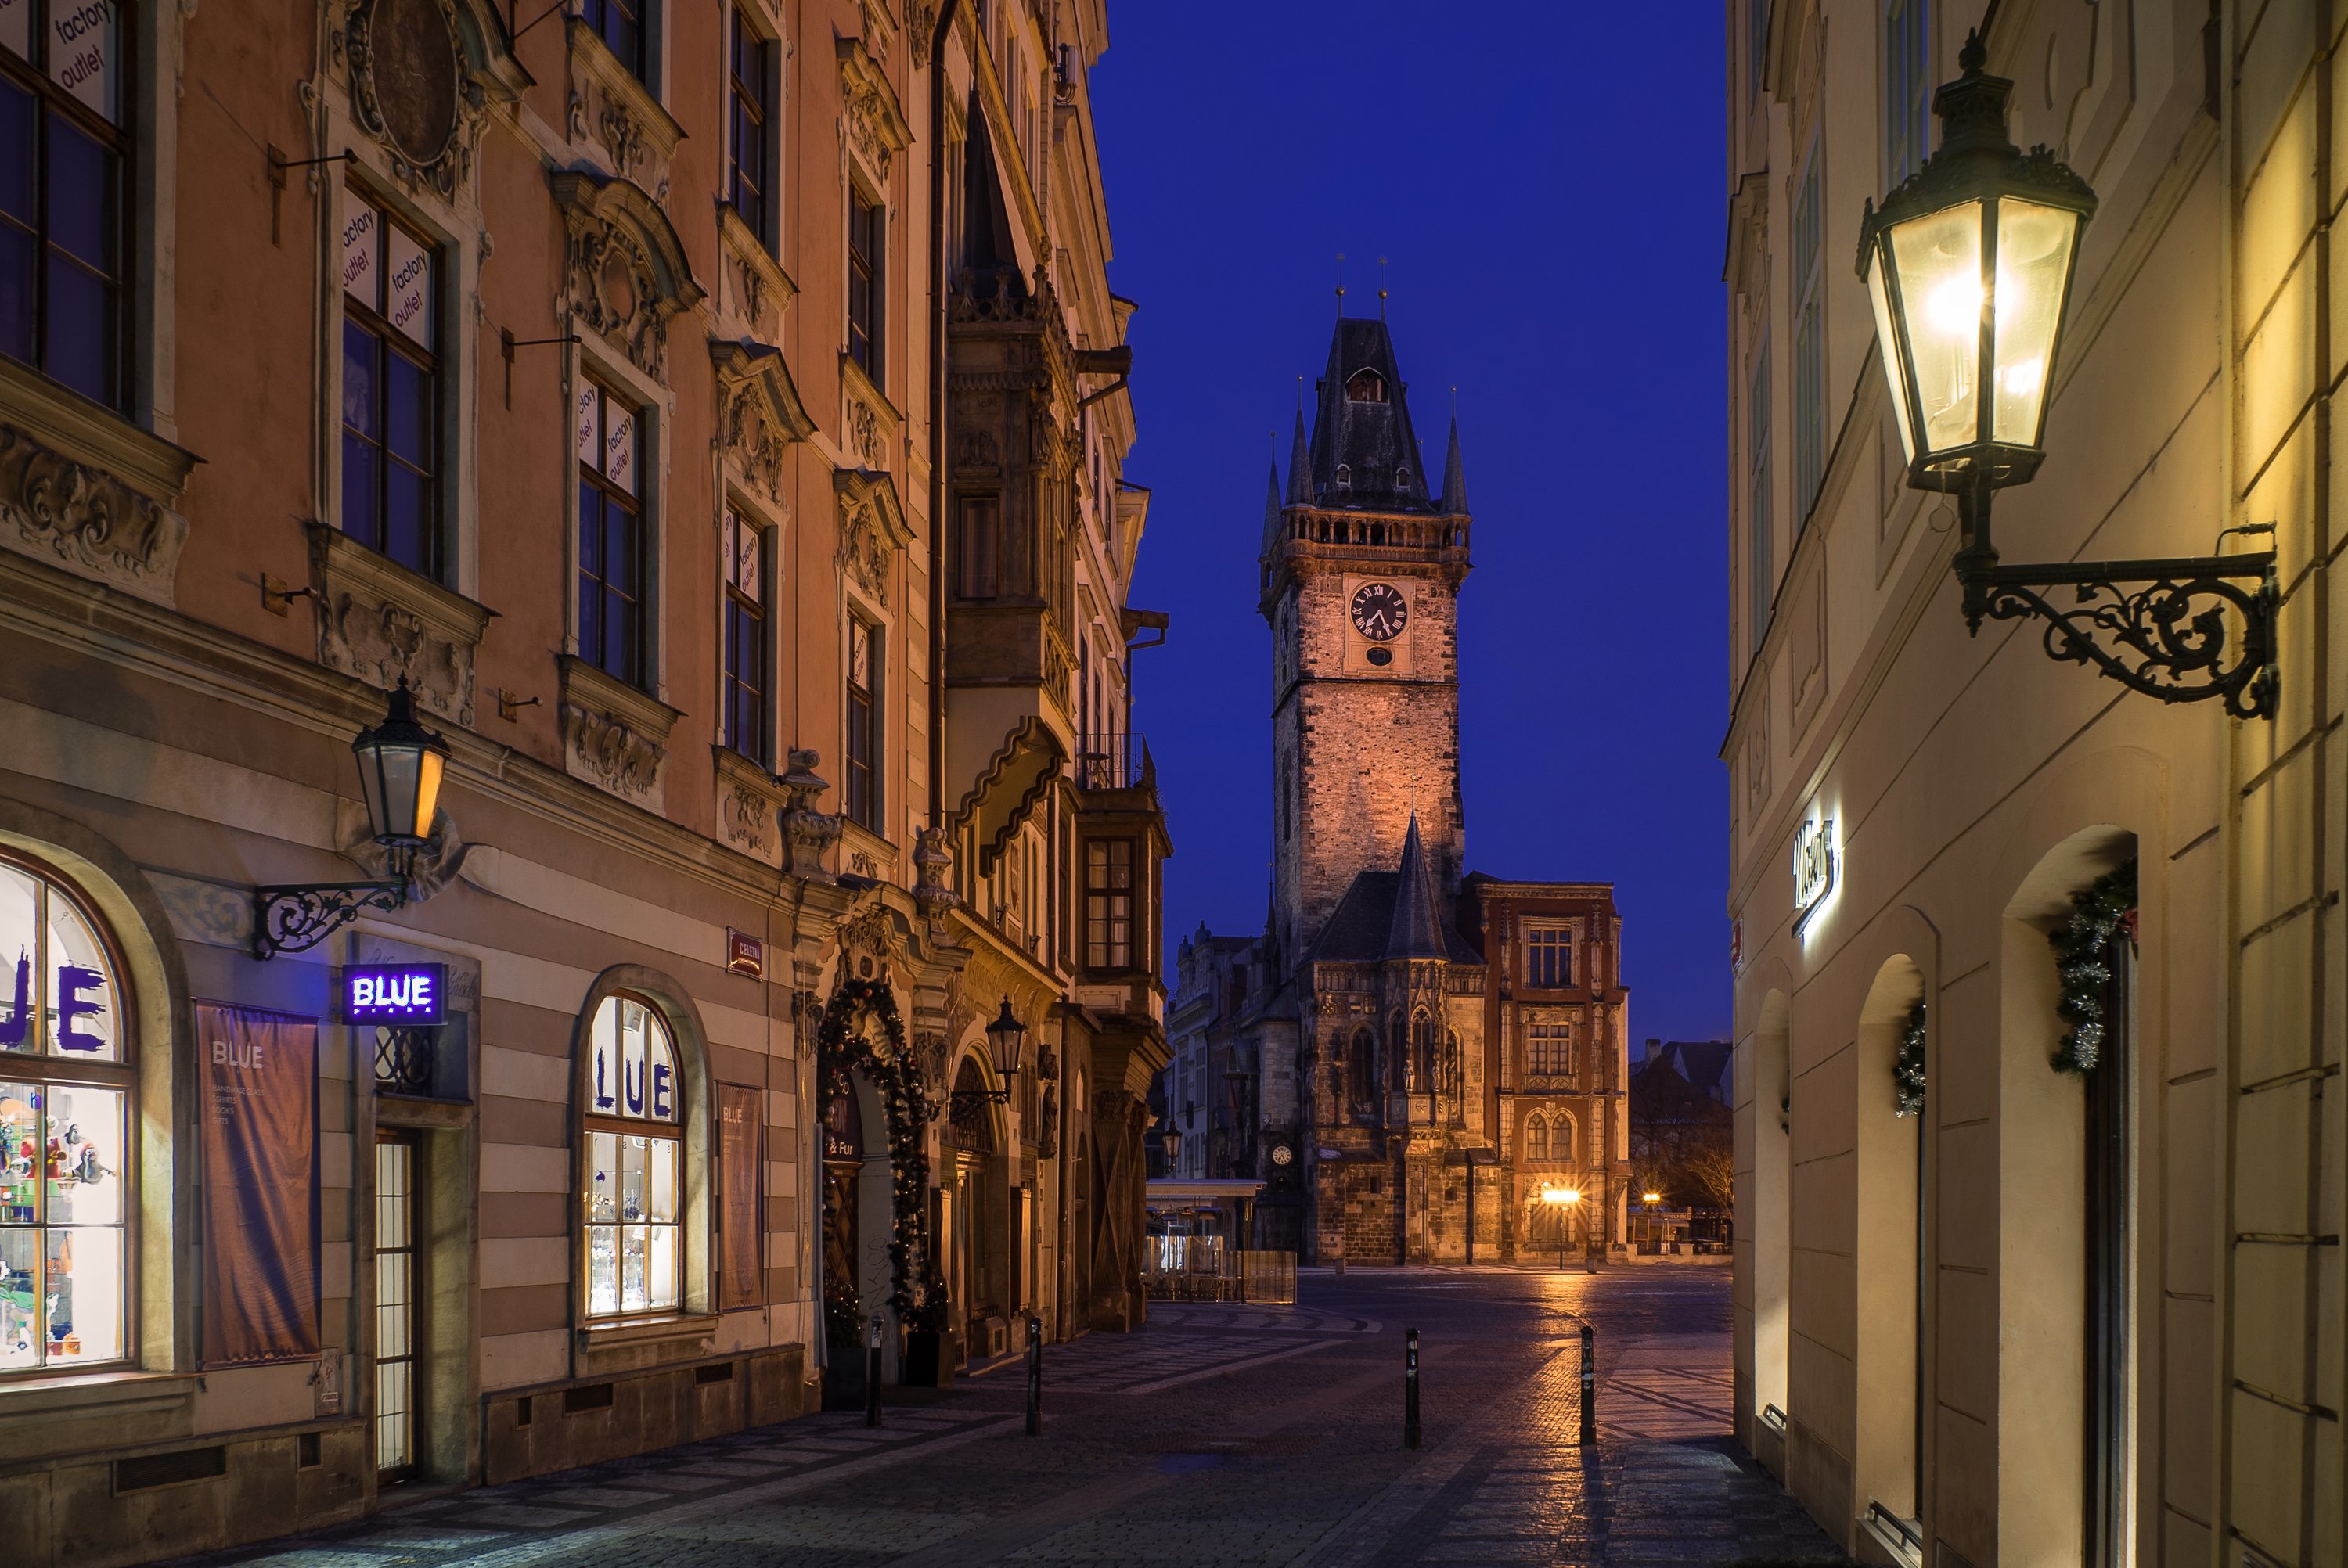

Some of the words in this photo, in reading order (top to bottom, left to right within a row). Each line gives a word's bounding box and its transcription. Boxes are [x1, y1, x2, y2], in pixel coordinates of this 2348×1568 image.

[55, 0, 112, 45] factory
[62, 44, 104, 89] outlet
[392, 251, 427, 293] factory
[395, 289, 423, 327] outlet
[608, 415, 632, 453] factory
[610, 448, 630, 481] outlet
[740, 534, 757, 567] factory
[353, 974, 431, 1006] BLUE
[213, 1040, 264, 1069] BLUE
[723, 1106, 742, 1124] BLUE
[839, 1142, 853, 1155] Fur
